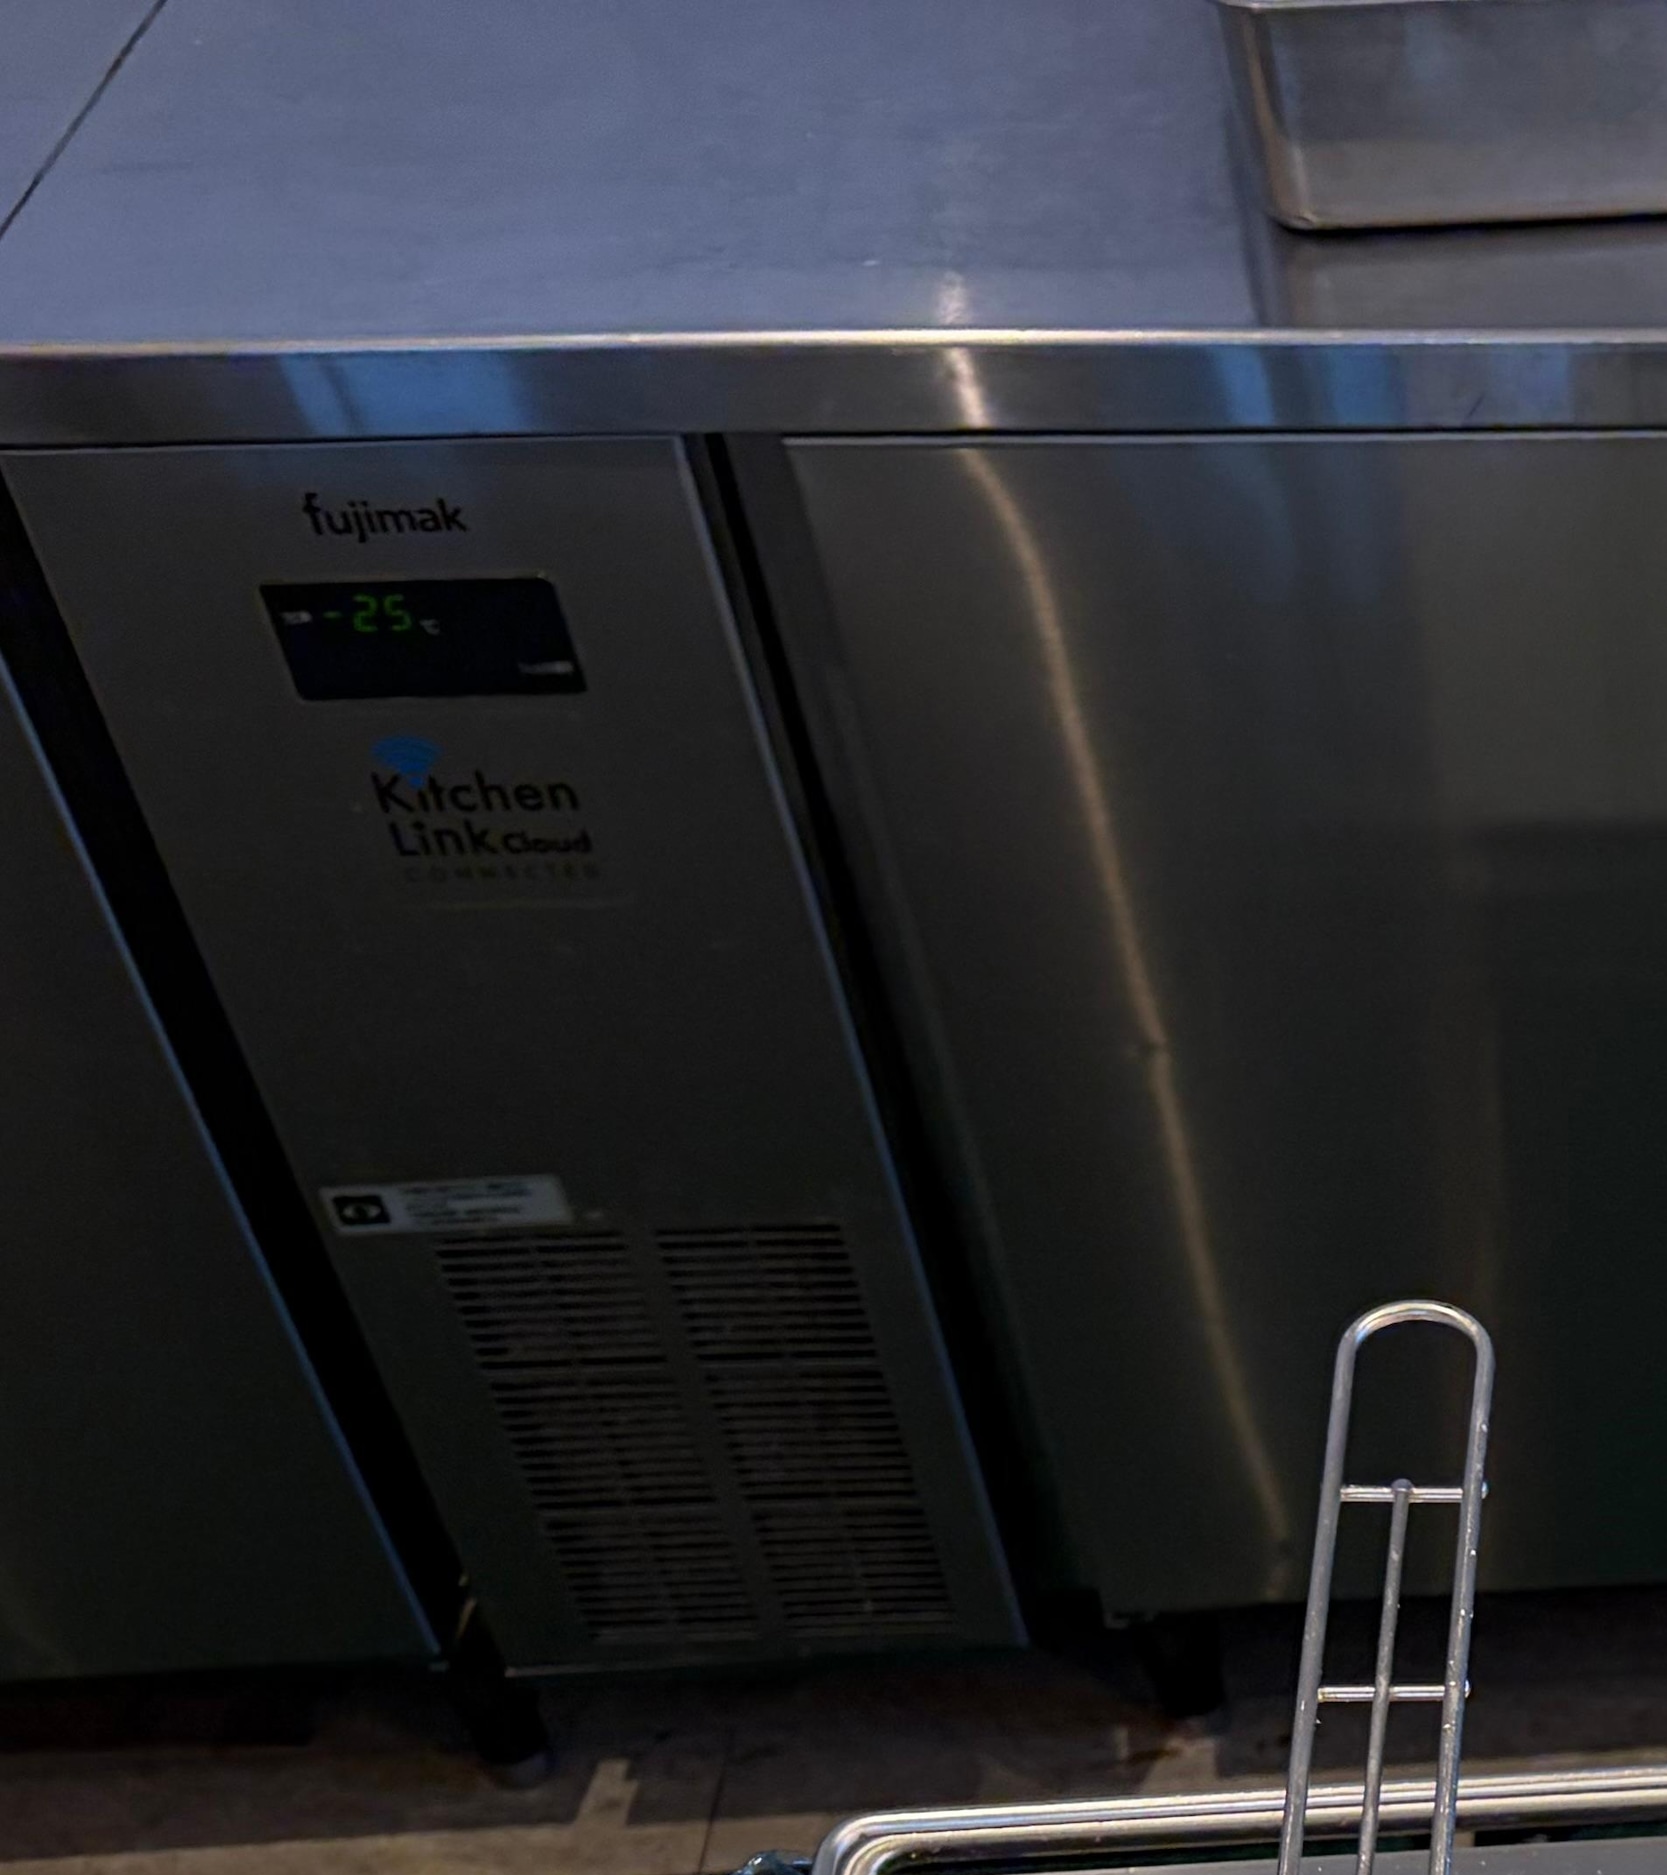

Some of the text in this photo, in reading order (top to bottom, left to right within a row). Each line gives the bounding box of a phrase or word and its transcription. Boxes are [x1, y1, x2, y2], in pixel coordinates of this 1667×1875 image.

[303, 493, 468, 543] fujimak
[370, 769, 580, 814] Kitchen
[388, 820, 593, 858] Link Cloud
